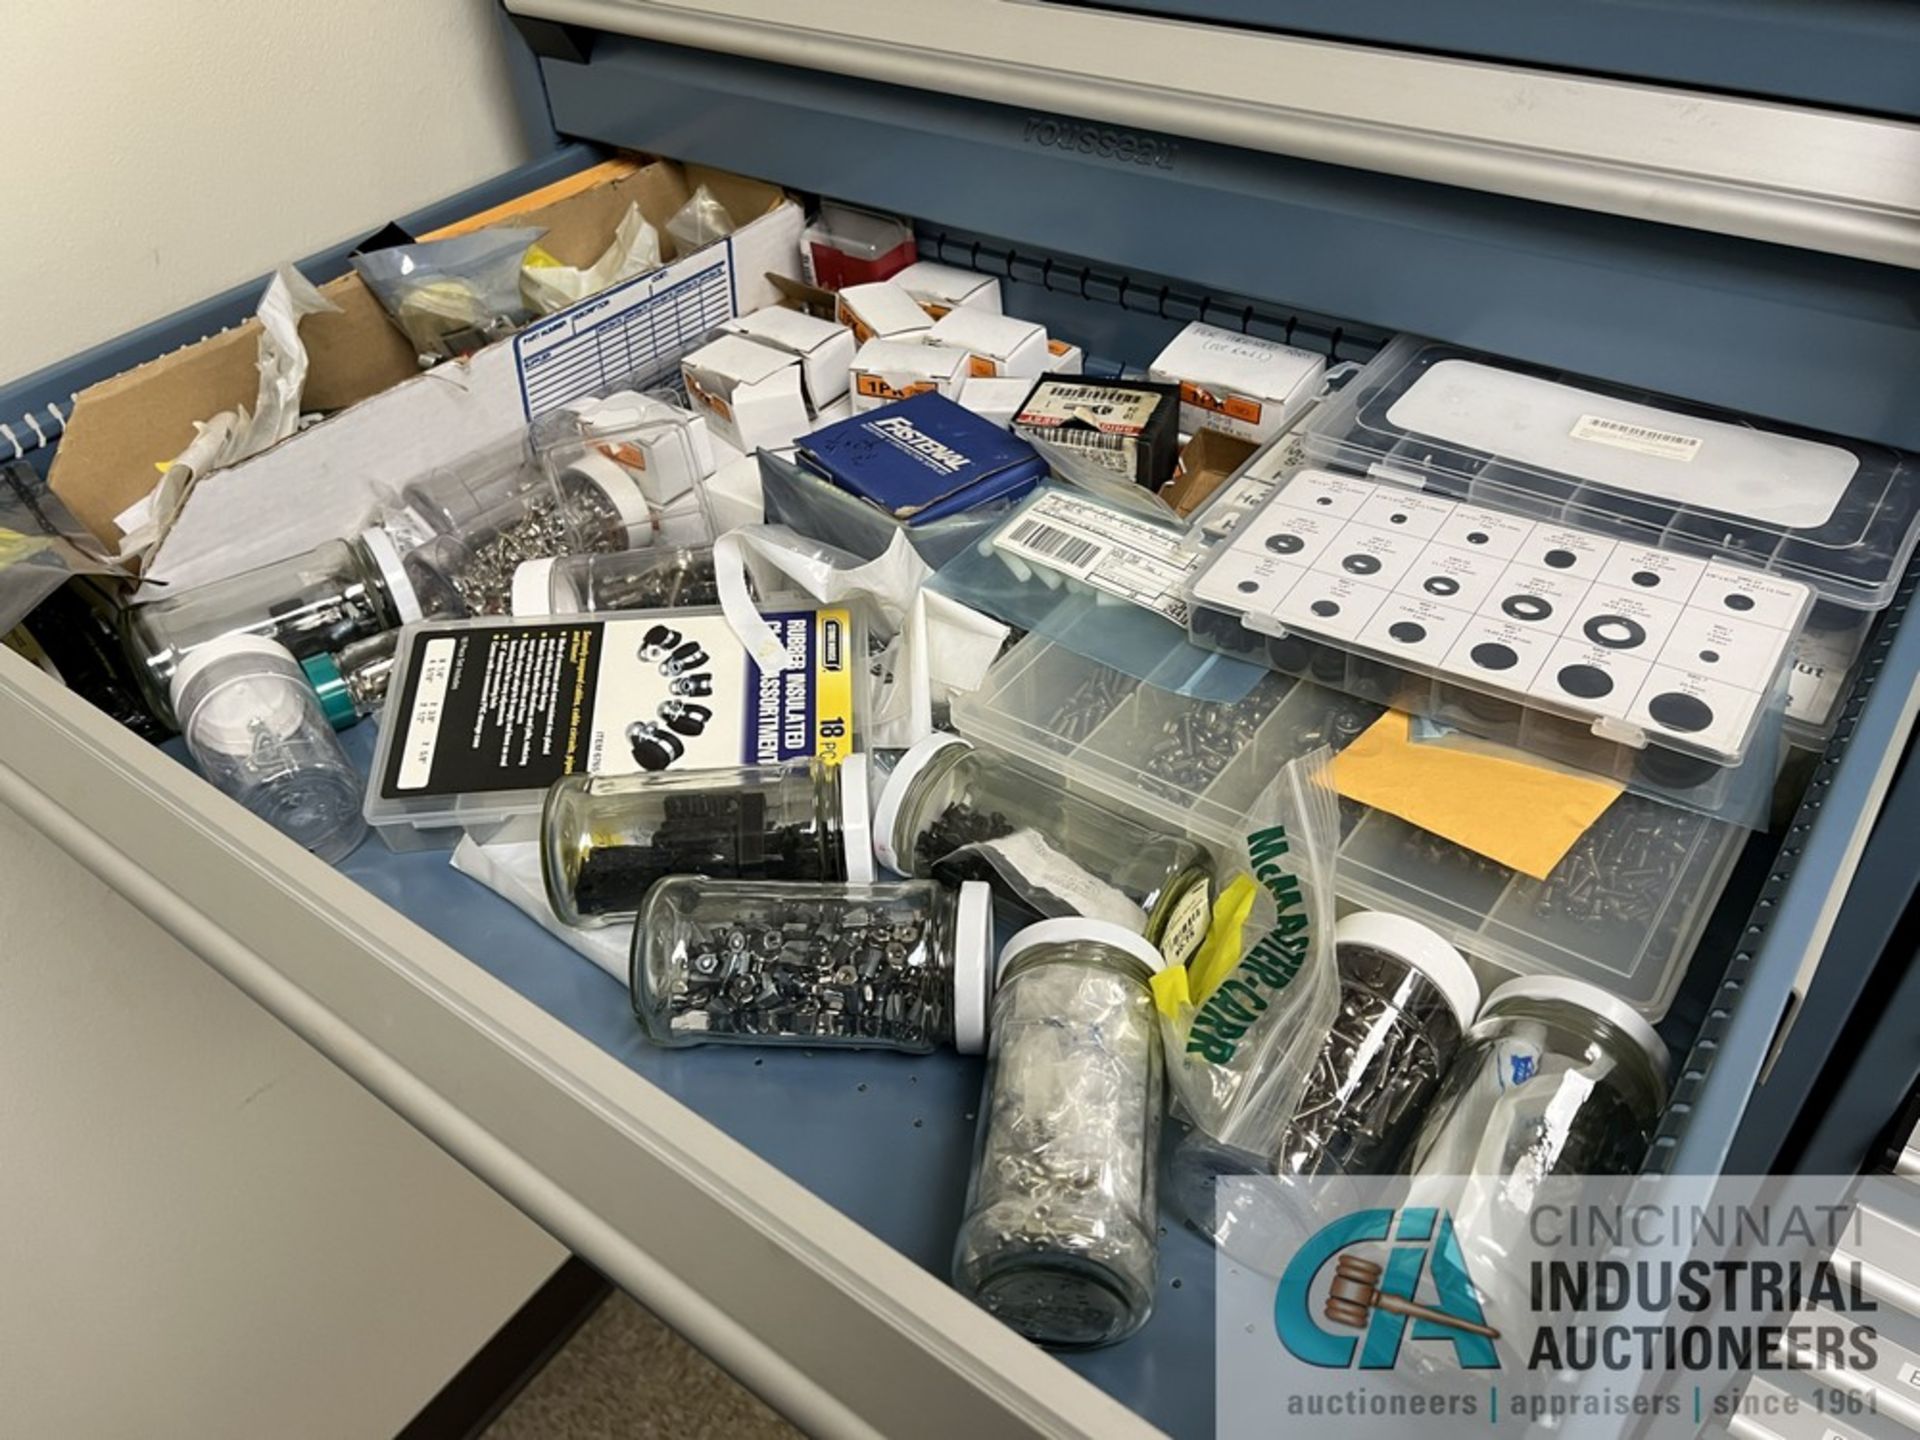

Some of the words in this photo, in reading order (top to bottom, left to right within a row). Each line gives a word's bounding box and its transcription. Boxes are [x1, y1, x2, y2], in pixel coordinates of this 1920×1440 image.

[875, 417, 970, 471] FASTENAL
[787, 619, 807, 671] RUBBER
[785, 673, 806, 750] INSULATED
[820, 716, 844, 738] 18
